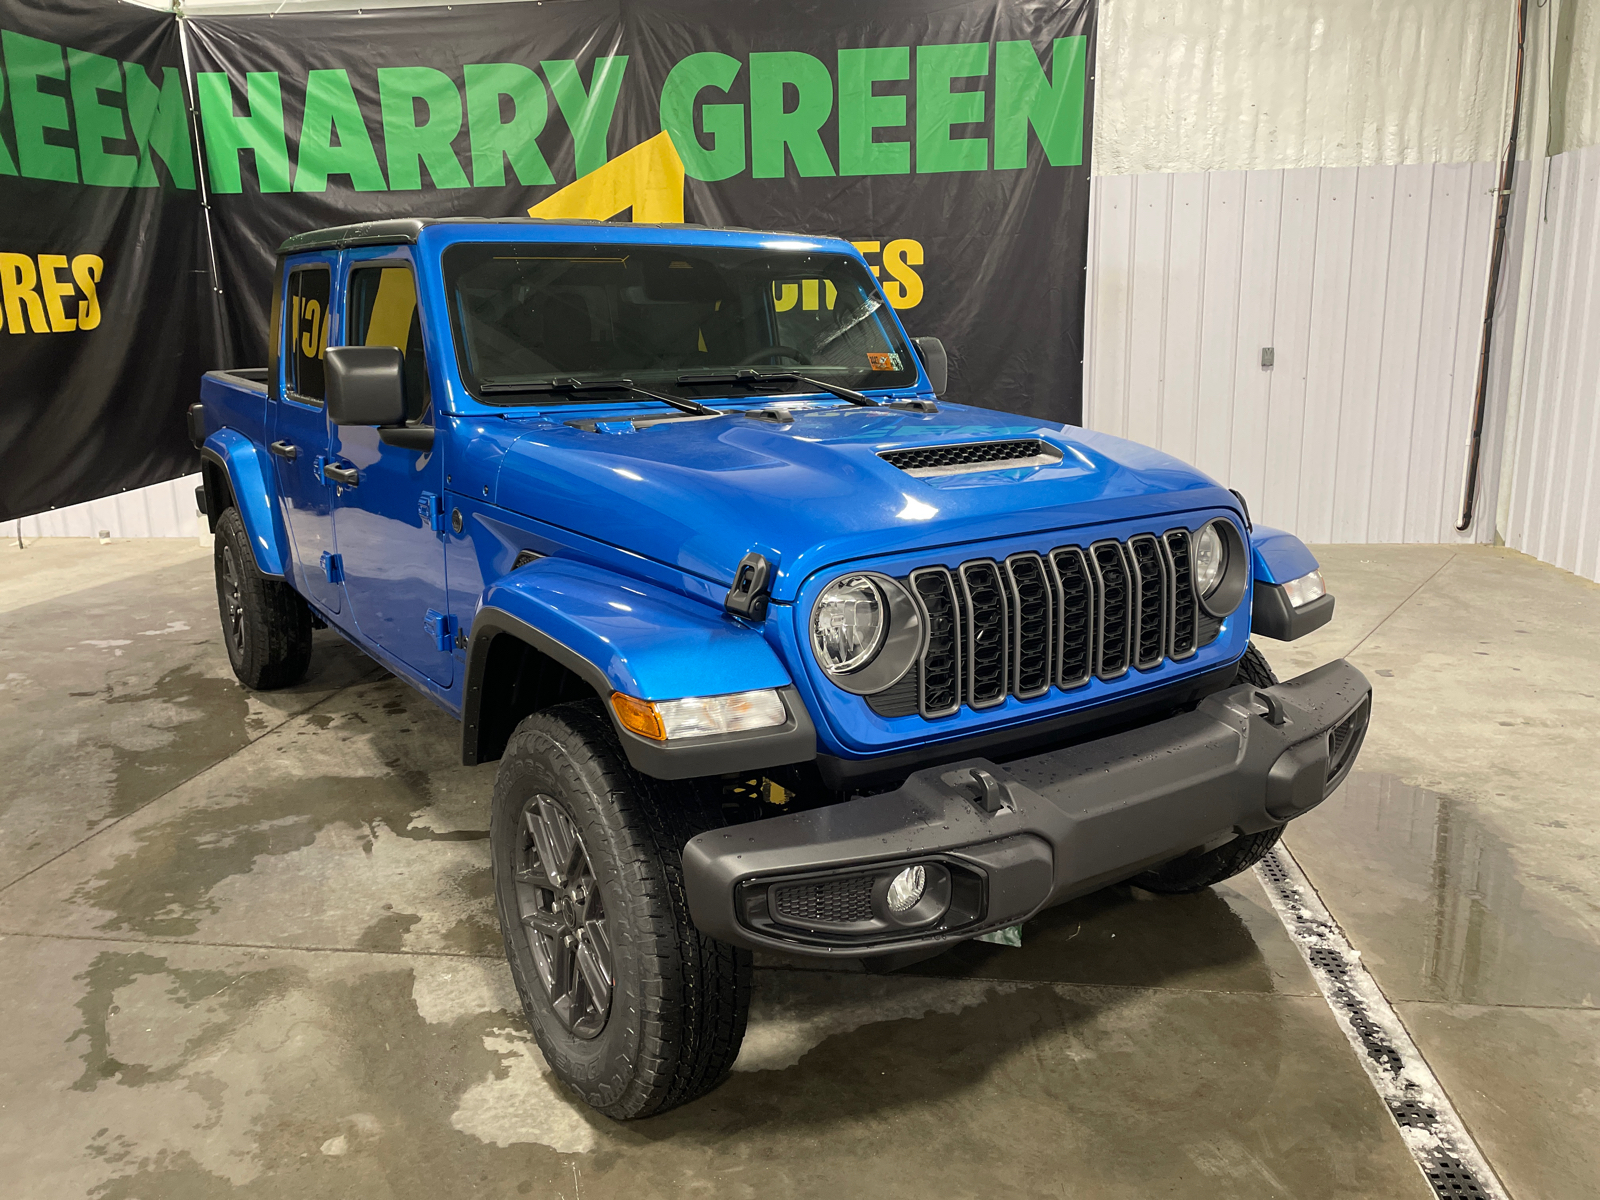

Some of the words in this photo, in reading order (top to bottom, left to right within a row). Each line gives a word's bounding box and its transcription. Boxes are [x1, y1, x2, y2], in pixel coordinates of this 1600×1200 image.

[0, 28, 197, 190] EEN
[196, 55, 629, 194] HARRY
[659, 35, 1087, 182] GREEN
[0, 252, 104, 334] RES
